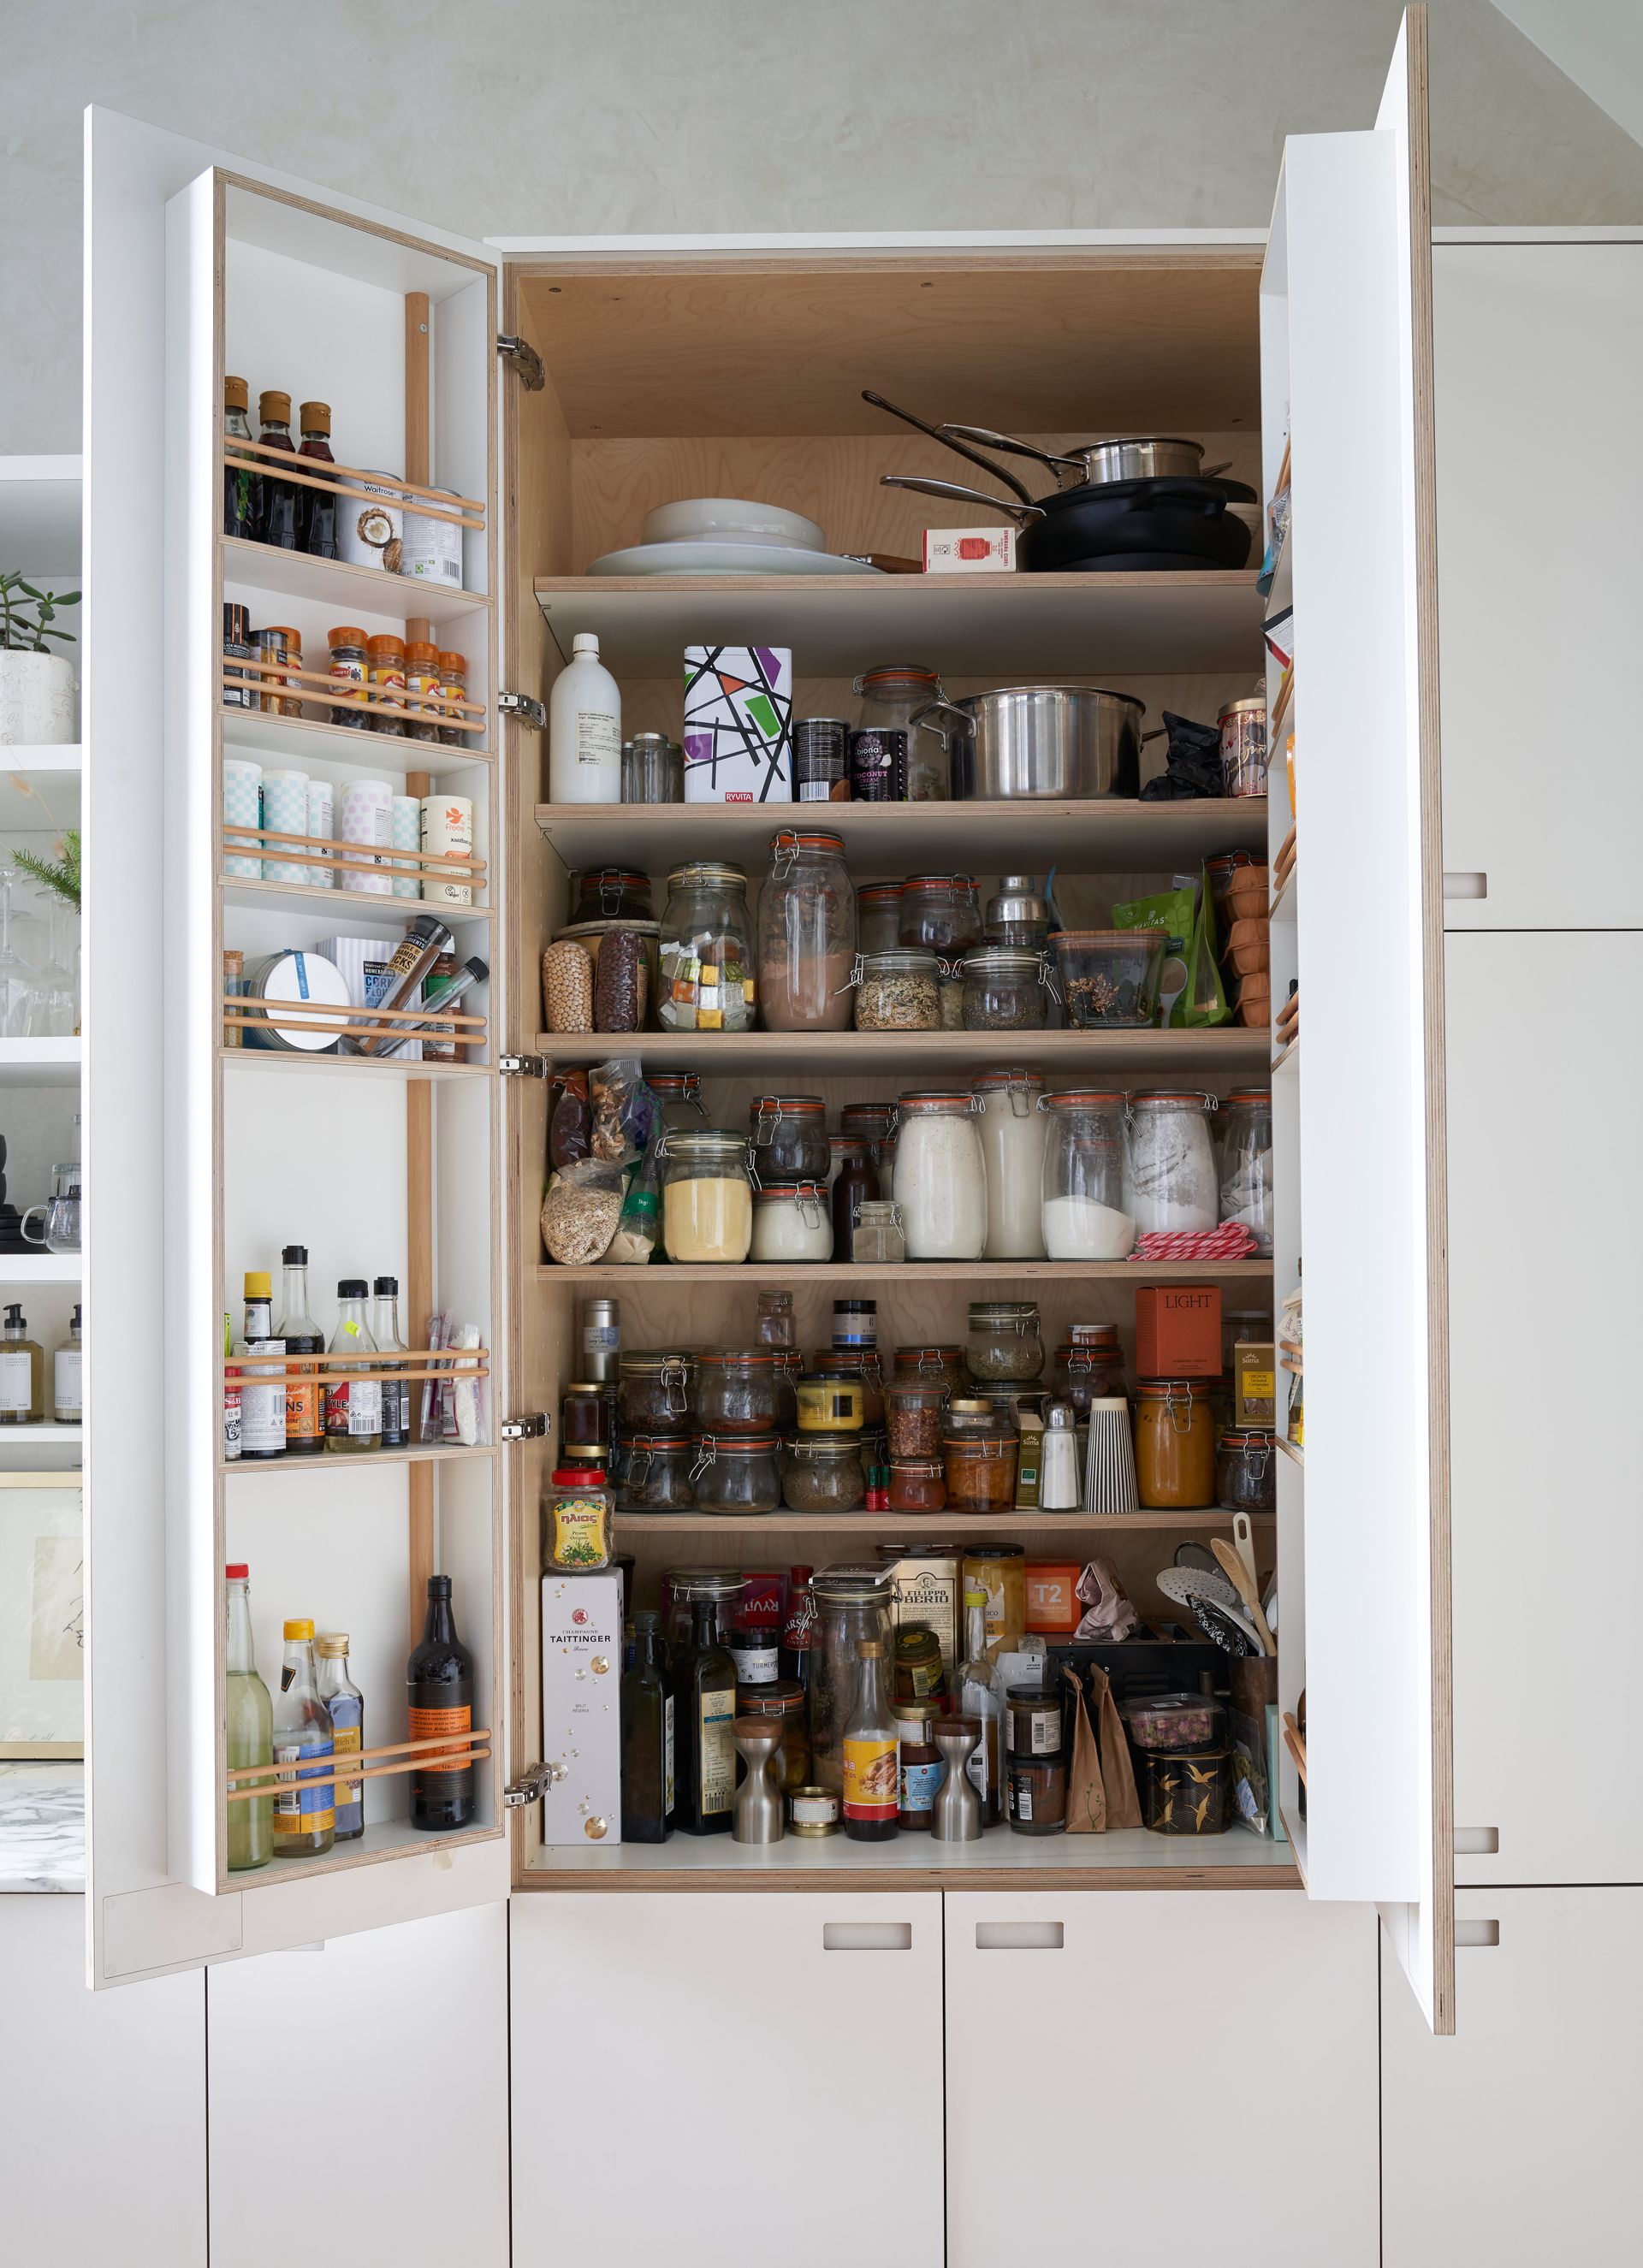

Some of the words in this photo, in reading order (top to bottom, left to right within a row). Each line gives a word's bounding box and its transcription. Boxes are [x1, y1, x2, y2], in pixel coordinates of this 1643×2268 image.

[364, 485, 394, 497] Waitrose
[857, 747, 879, 755] biona
[853, 771, 888, 779] COCONUT
[726, 793, 752, 802] RYVITA
[1134, 916, 1165, 930] NAVITAS
[365, 976, 394, 988] CORN
[1165, 1294, 1213, 1309] LIGHT
[1034, 1584, 1063, 1603] T2
